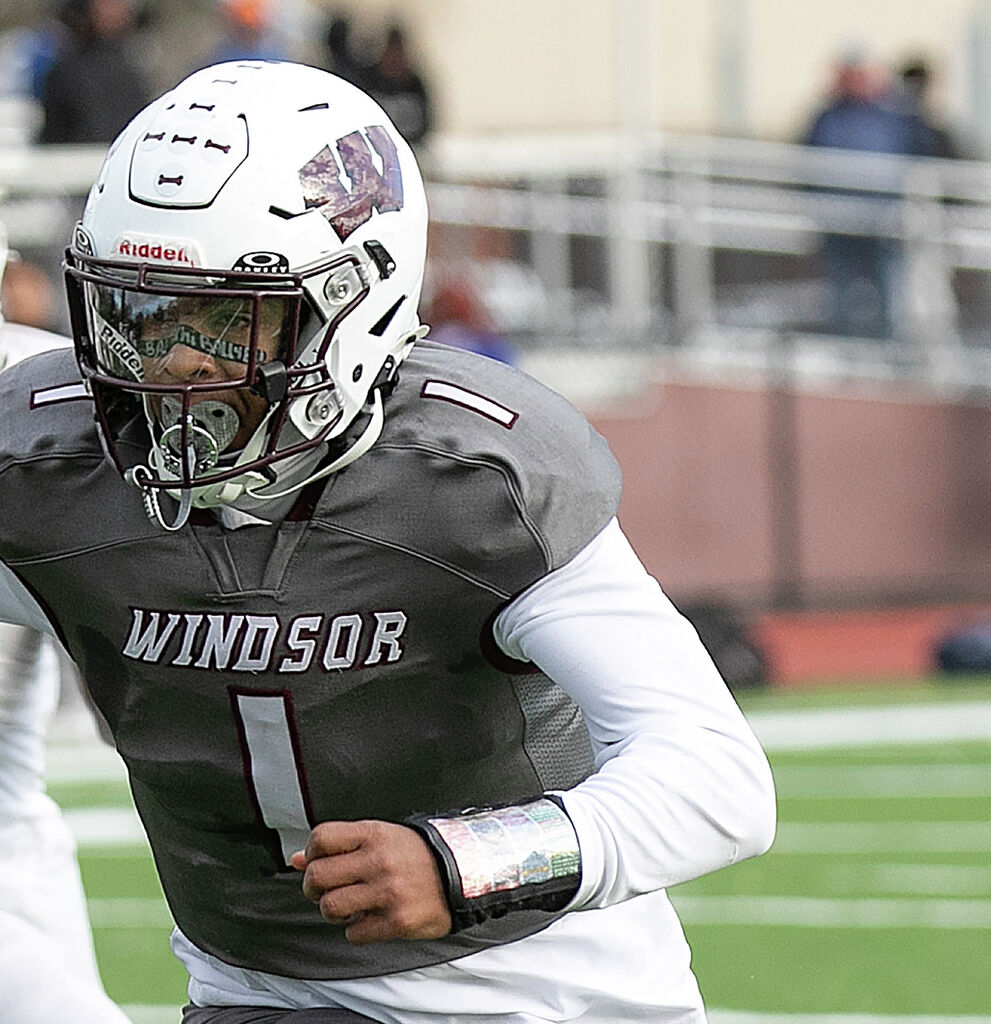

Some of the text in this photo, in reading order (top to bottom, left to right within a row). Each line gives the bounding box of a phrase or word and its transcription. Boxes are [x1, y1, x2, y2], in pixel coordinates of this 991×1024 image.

[298, 125, 404, 244] W
[420, 379, 519, 430] 1
[121, 607, 408, 674] WINDSOR
[228, 686, 316, 873] 1
